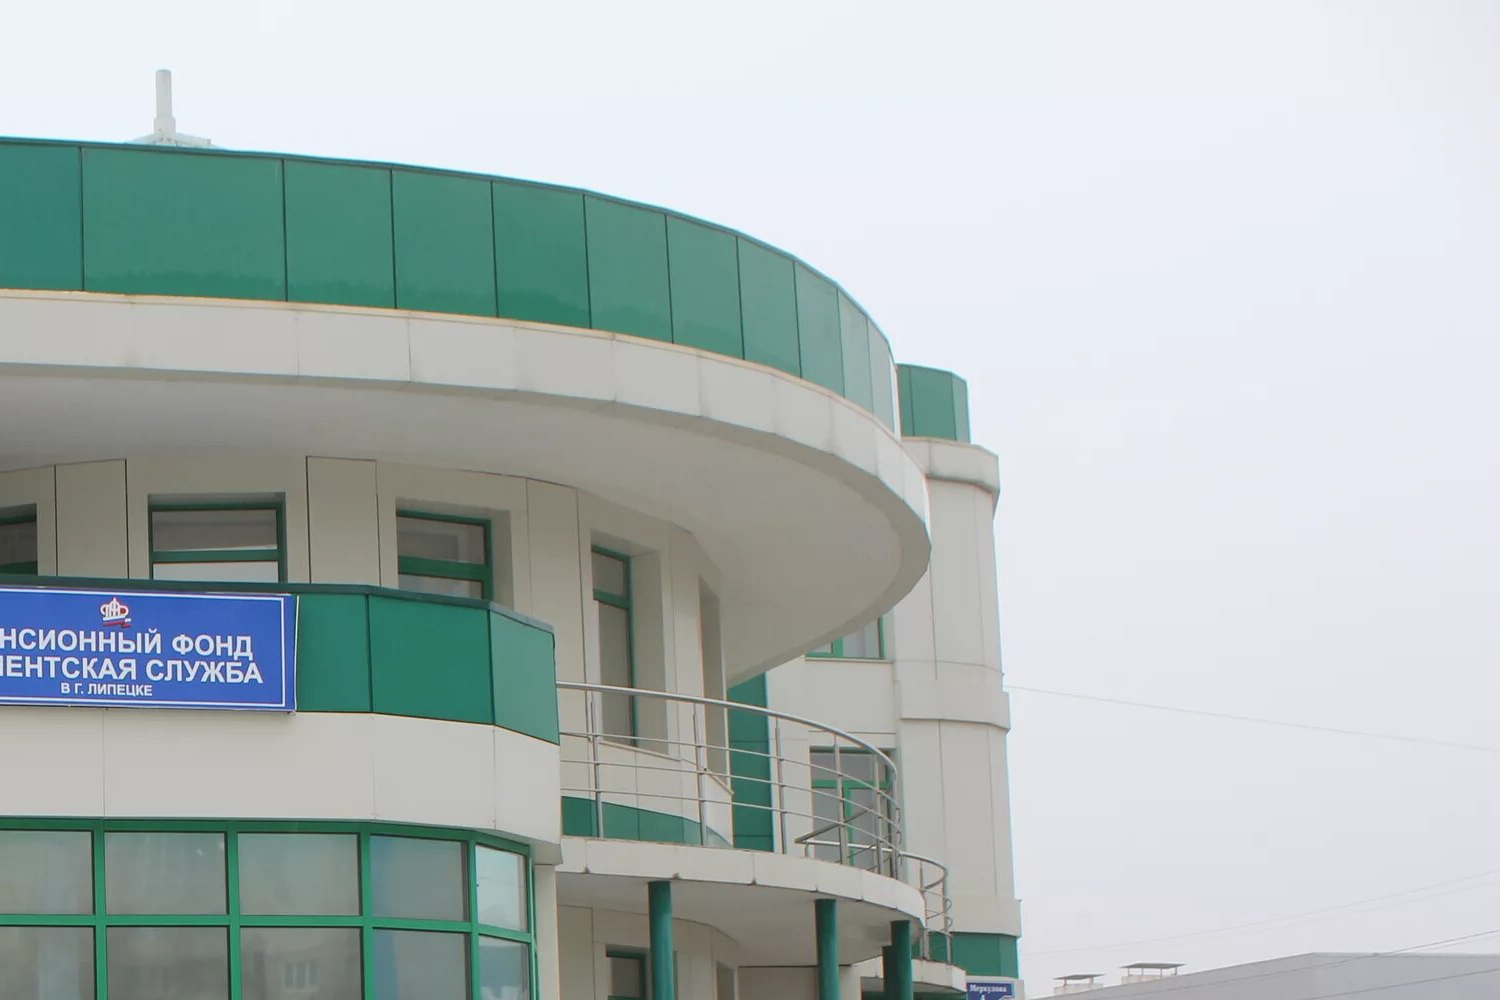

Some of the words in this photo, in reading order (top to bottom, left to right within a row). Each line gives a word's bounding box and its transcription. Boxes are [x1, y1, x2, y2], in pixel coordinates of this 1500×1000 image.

[171, 633, 253, 661] ФОНД
[146, 659, 263, 683] СЛУЖБА
[61, 683, 70, 694] В
[74, 683, 84, 695] Г.
[87, 684, 153, 698] ЛИПЕЦКЕ
